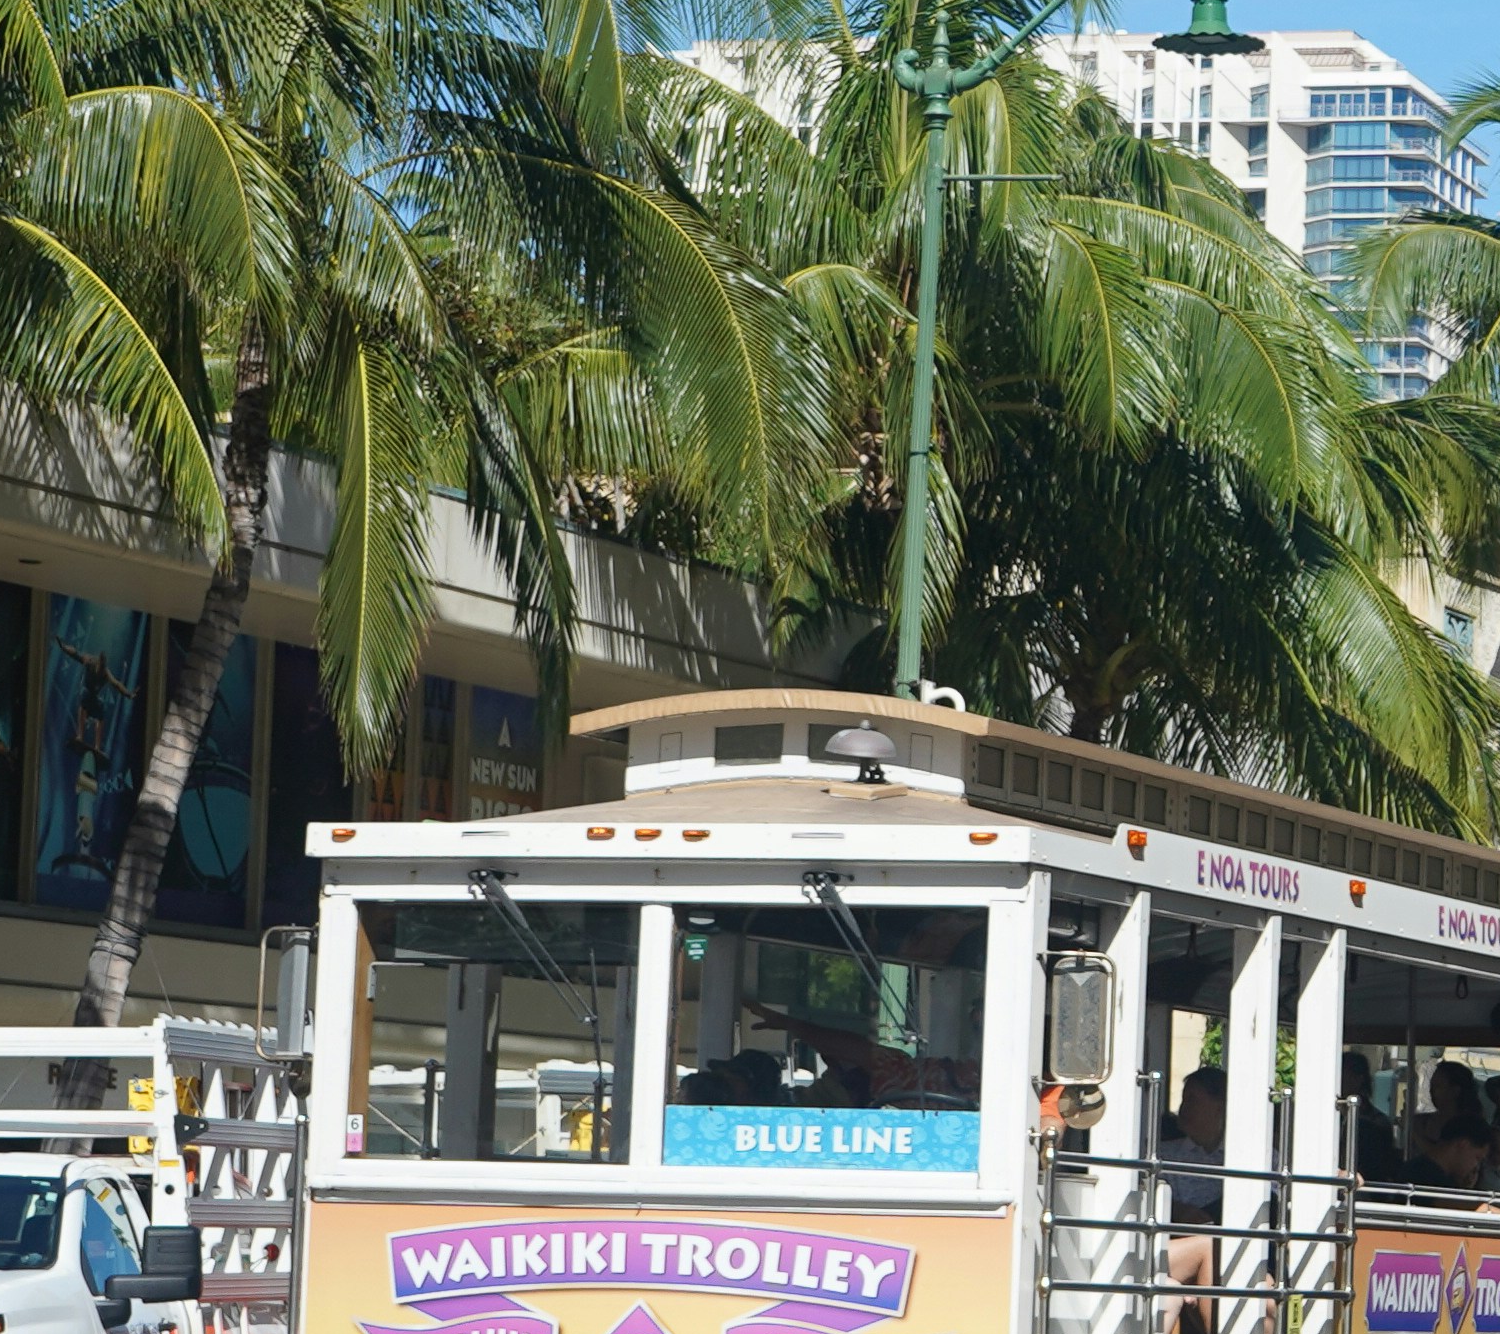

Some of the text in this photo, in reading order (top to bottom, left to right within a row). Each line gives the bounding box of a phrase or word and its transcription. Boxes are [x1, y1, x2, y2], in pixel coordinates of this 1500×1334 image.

[498, 717, 511, 747] A
[470, 756, 537, 792] NEW SUN
[1197, 850, 1299, 903] E NOA TOURS
[1438, 906, 1445, 937] E
[1448, 908, 1477, 943] NOA
[351, 1118, 359, 1130] 6
[735, 1124, 913, 1154] BLUE LINE
[401, 1232, 896, 1298] WAIKIKI TROLLEY
[1372, 1272, 1440, 1313] WAIKIKI
